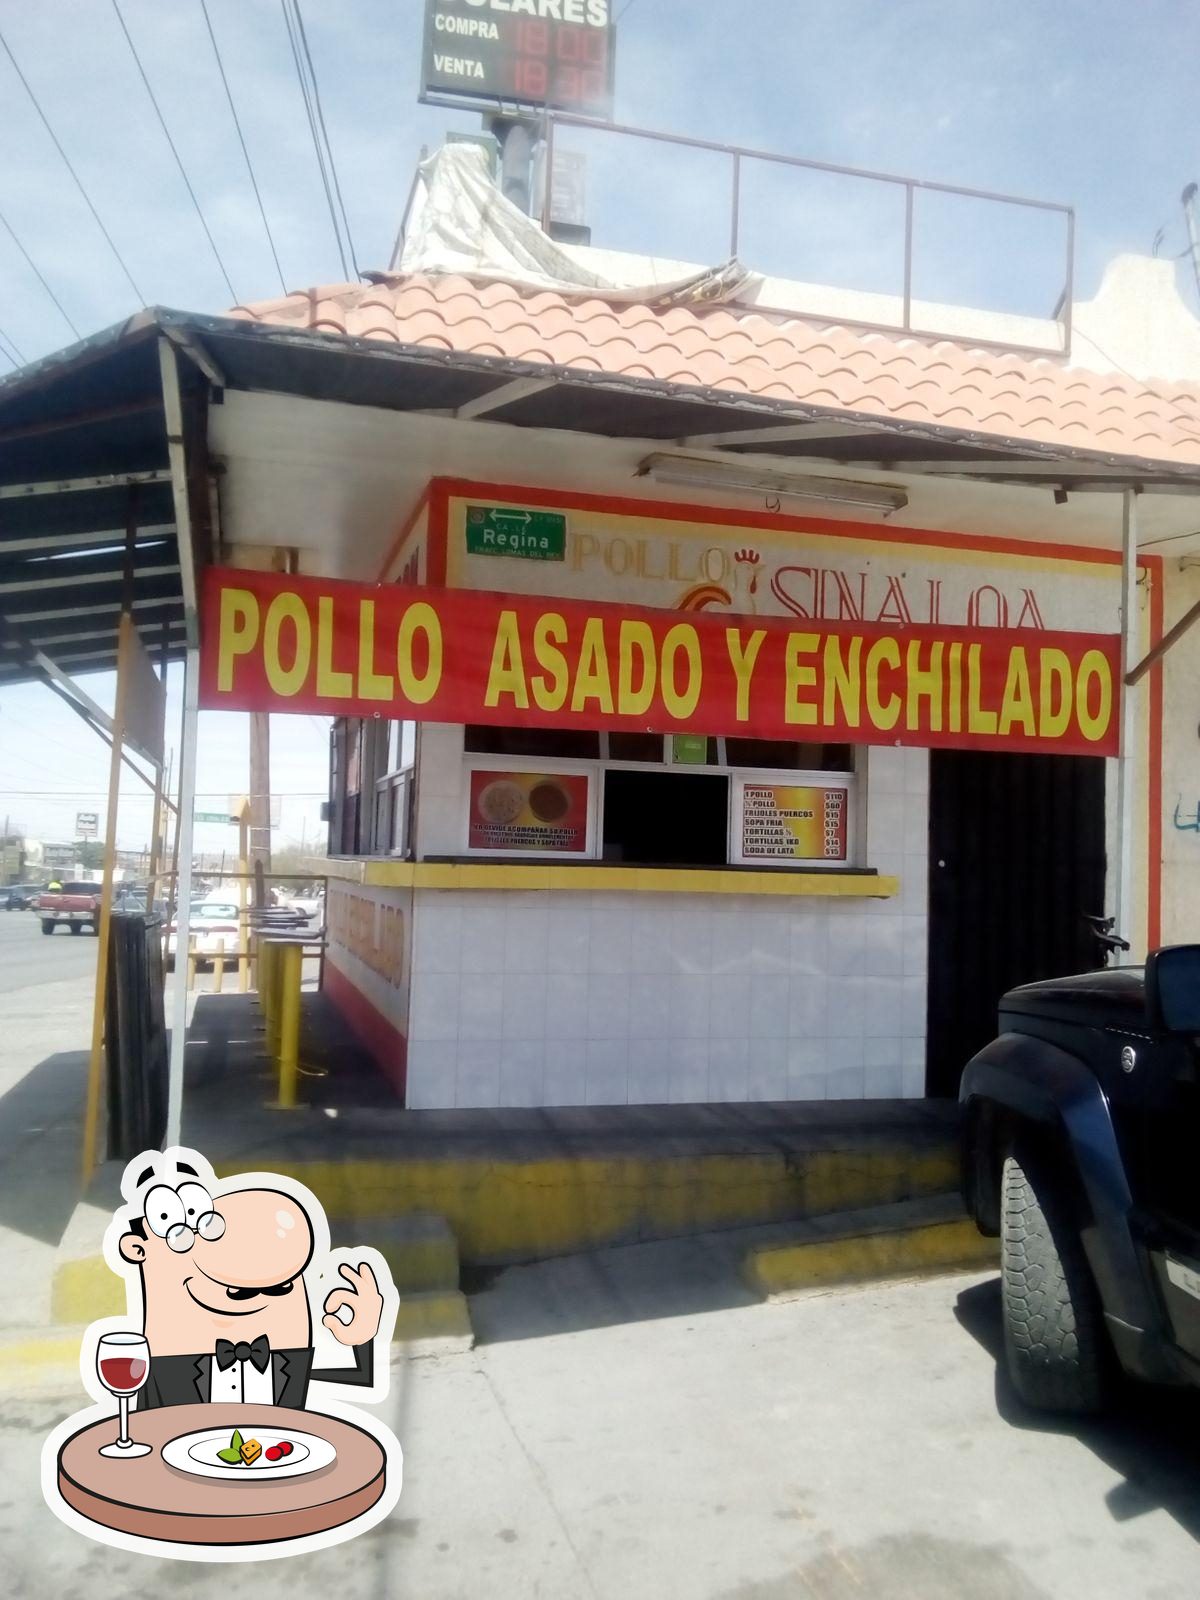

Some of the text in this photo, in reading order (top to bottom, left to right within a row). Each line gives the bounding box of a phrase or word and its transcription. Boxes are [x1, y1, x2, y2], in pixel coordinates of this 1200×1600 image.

[435, 14, 499, 40] COMPRA
[433, 54, 485, 79] VENTA
[483, 528, 549, 549] Regina
[569, 532, 732, 583] POLLO
[217, 588, 1112, 742] POLLO ASADO Y ENCHILADO
[753, 800, 776, 808] POLLO
[745, 809, 778, 817] FRIJOLES
[745, 818, 765, 826] SOPA
[745, 828, 784, 836] TORTILLAS
[745, 837, 784, 845] TORTILLAS
[778, 847, 795, 855] LATA
